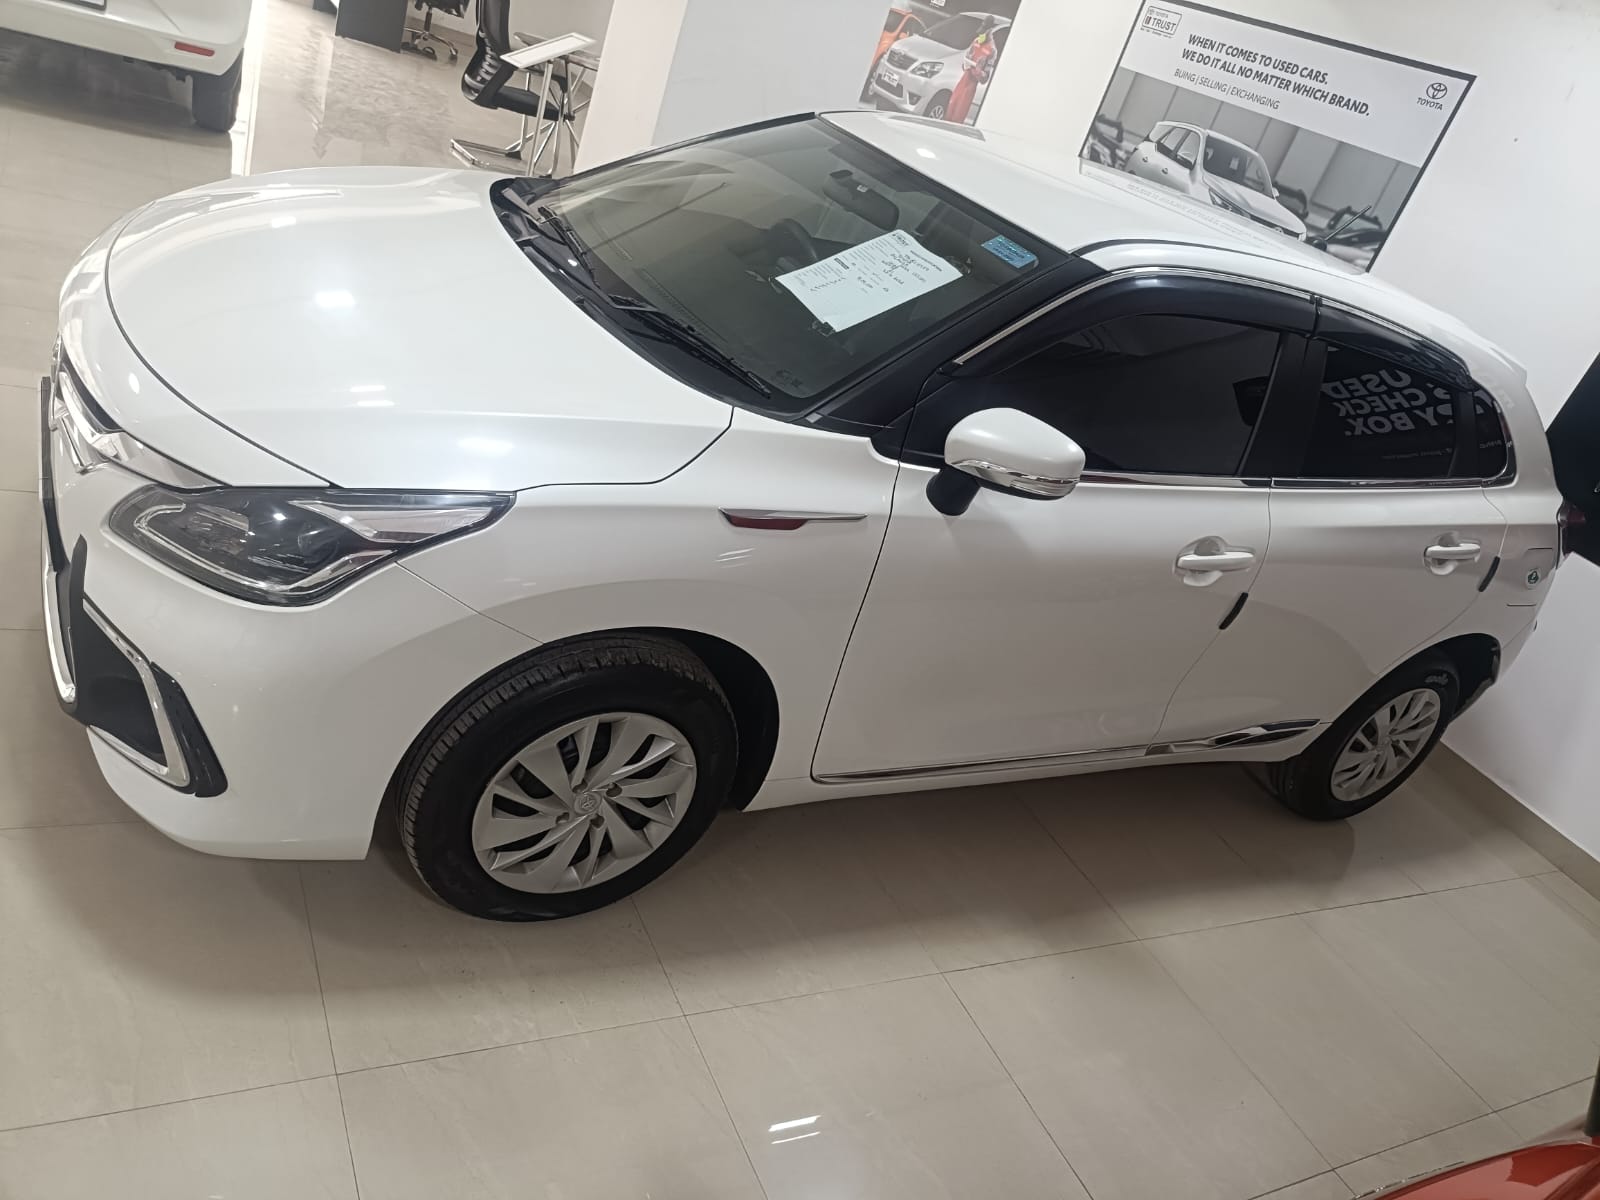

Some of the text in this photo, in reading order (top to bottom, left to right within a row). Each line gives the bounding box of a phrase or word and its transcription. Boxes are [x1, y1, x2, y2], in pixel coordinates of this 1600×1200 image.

[1151, 17, 1177, 31] TRUST
[1187, 33, 1328, 85] WHEN IT COMES TO USED CARS.
[1181, 48, 1370, 116] WE DO IT ALL NO MATTER WHICH BRAND.
[1199, 76, 1228, 93] SELLING
[1230, 87, 1280, 110] EXCHANGING
[1416, 97, 1443, 111] TOYOTA
